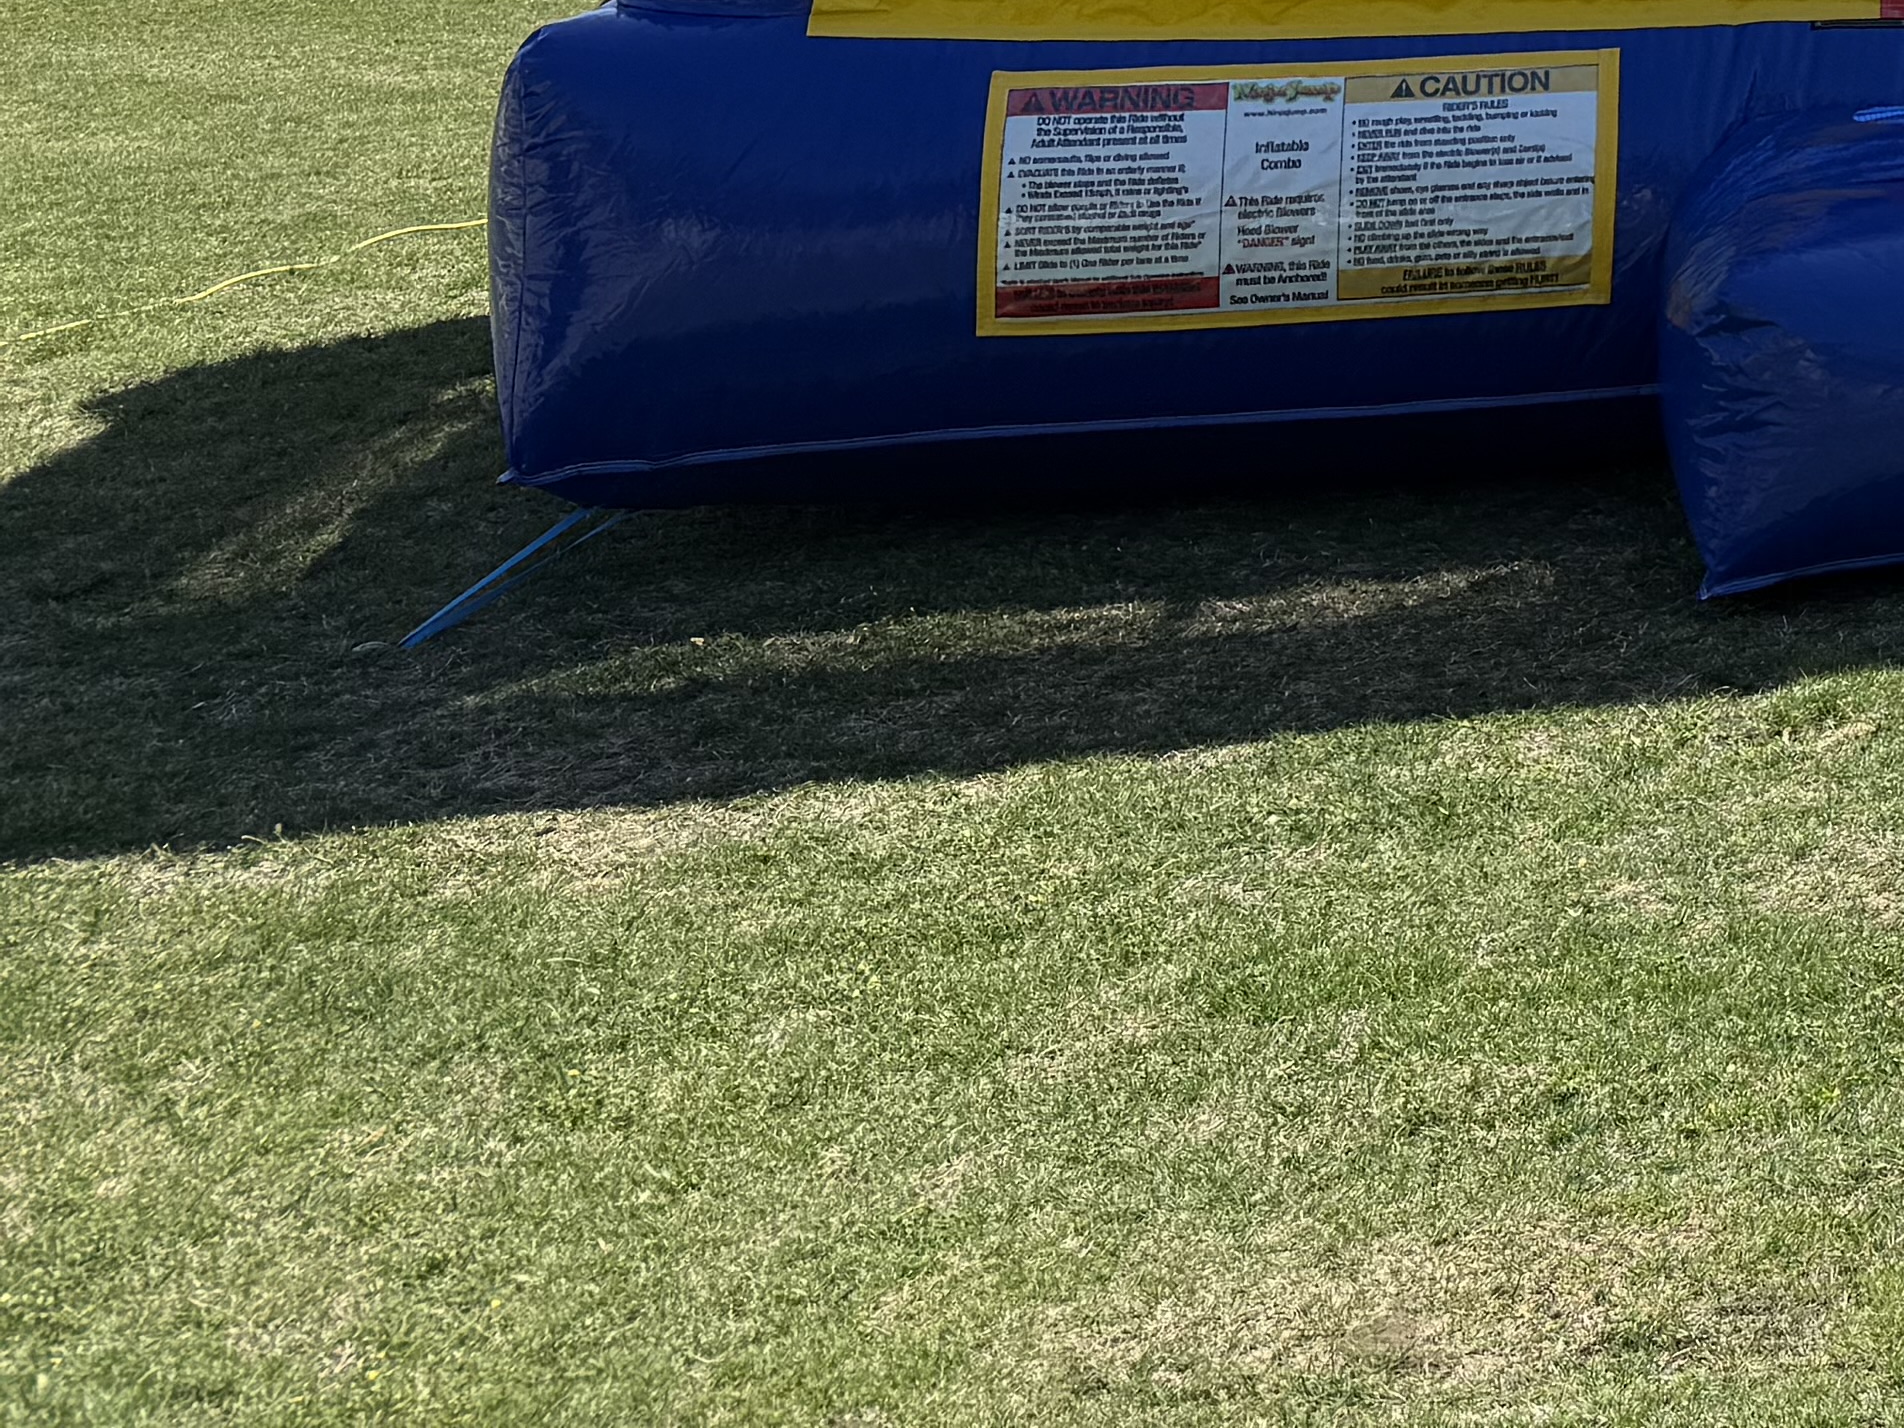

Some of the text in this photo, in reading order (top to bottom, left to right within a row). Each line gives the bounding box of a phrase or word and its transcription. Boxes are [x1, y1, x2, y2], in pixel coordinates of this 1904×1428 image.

[1419, 71, 1549, 96] CAUTION
[1048, 87, 1195, 111] WARNING
[1255, 139, 1309, 152] Inflatable
[1261, 157, 1301, 170] Combo
